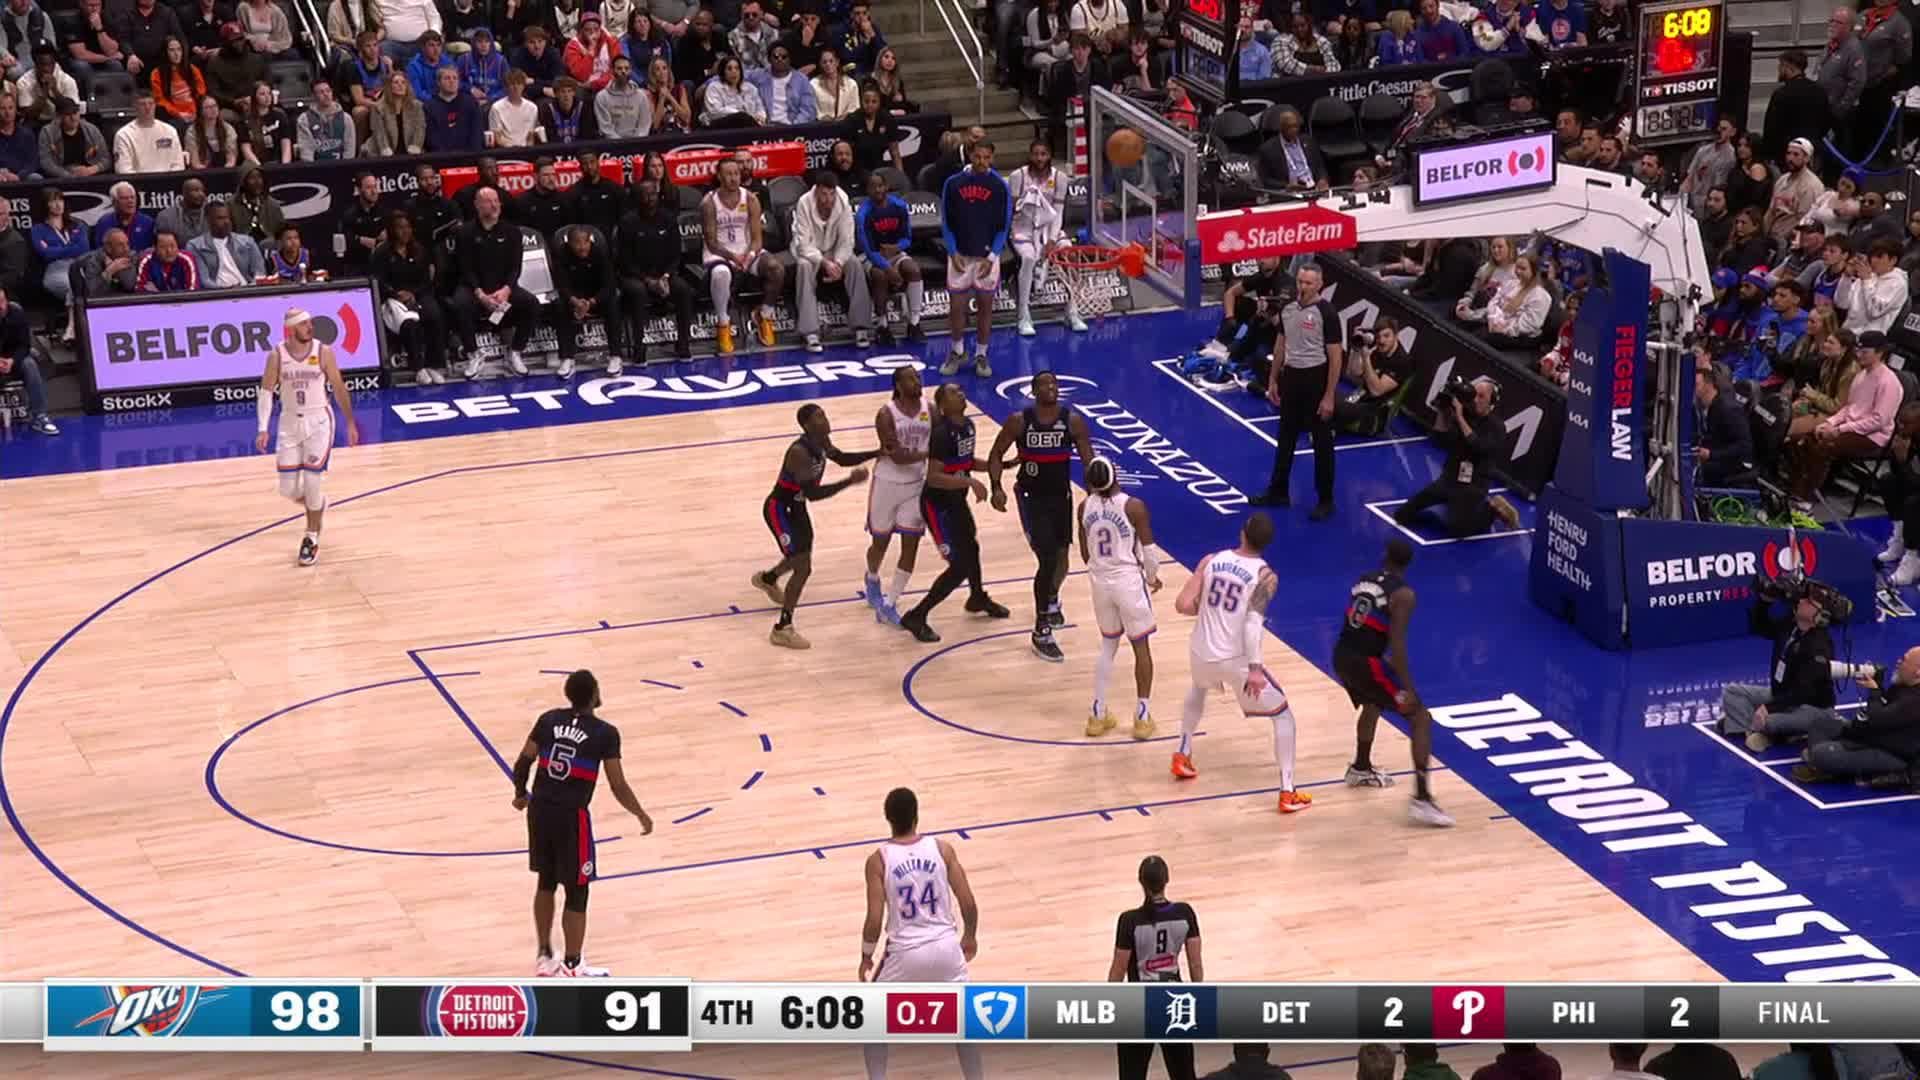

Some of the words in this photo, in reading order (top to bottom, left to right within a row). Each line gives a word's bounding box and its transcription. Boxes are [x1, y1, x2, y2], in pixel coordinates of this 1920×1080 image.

[1664, 8, 1711, 38] 6:08
[1663, 78, 1717, 95] TISSOT
[1427, 158, 1503, 185] BELFOR
[106, 320, 273, 364] BELFOR
[103, 392, 172, 411] StockX
[1026, 431, 1064, 448] DET
[1025, 462, 1039, 476] 0
[1072, 399, 1249, 515] LUNAZUL
[1097, 527, 1113, 558] 2
[1547, 510, 1588, 546] HENRY
[1547, 531, 1577, 561] FORD
[1547, 550, 1592, 592] HEALTH
[1647, 551, 1757, 586] BELFOR
[1208, 577, 1243, 614] 55
[553, 725, 589, 745] BEASLEY
[547, 743, 577, 781] 5
[1428, 692, 1728, 853] DETROIT
[892, 858, 937, 880] WILLIAMS
[896, 881, 938, 920] 34
[1156, 929, 1168, 954] 9
